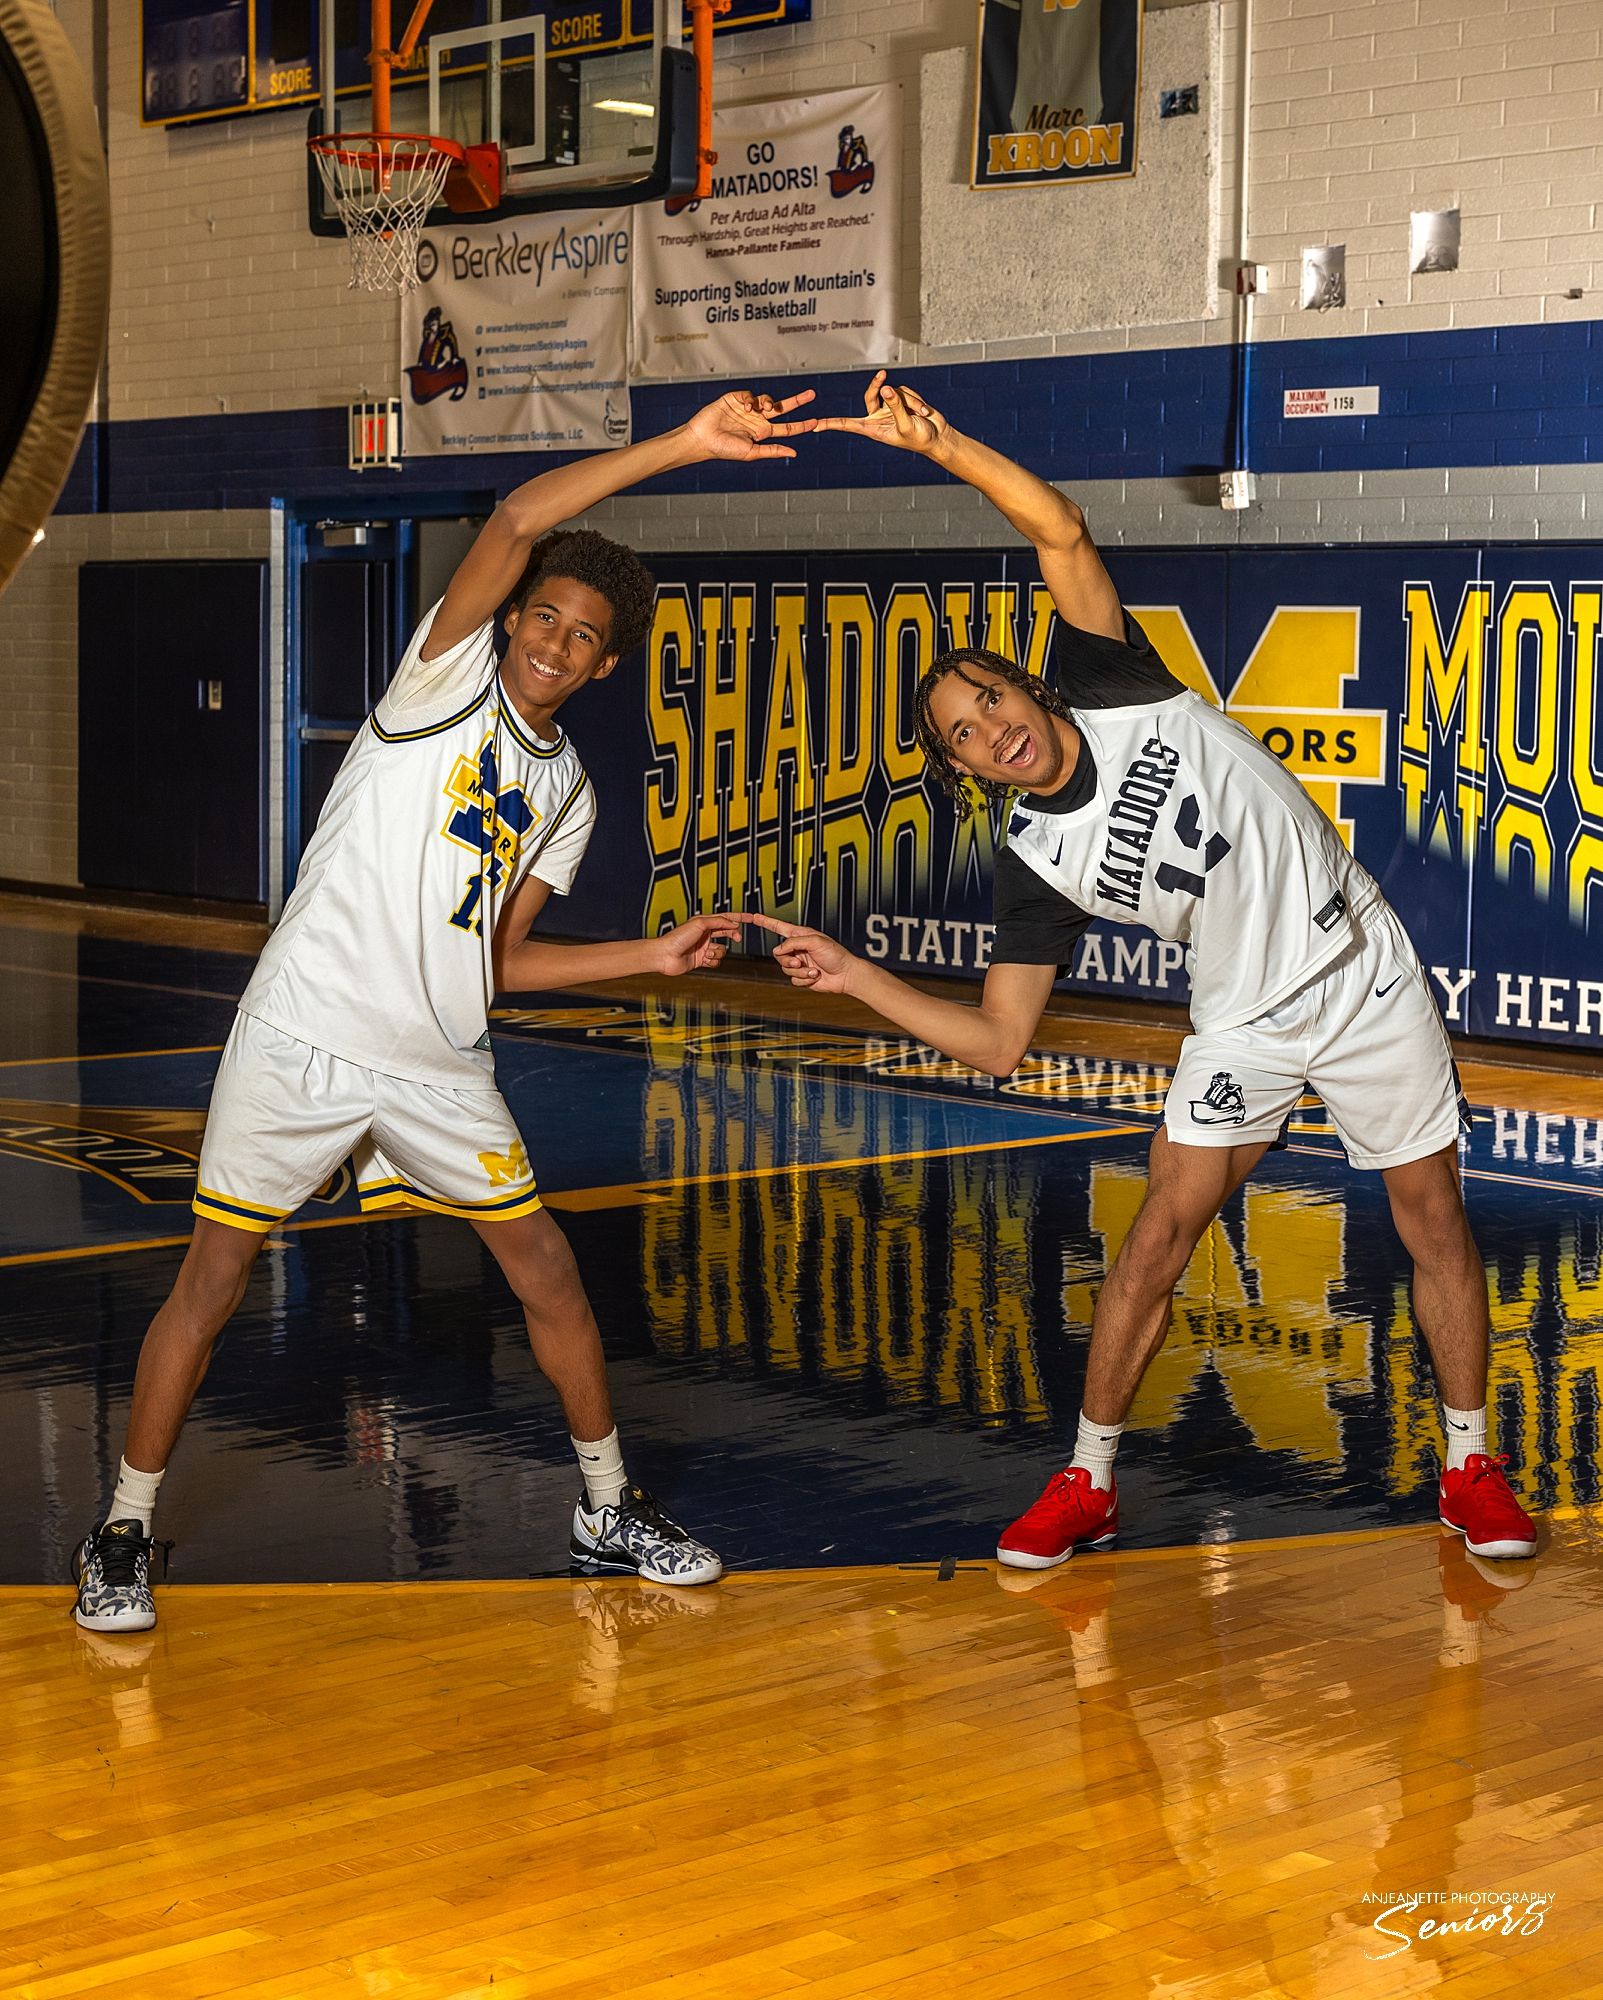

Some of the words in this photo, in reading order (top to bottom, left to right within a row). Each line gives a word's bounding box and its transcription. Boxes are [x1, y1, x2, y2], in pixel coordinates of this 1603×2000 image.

[551, 13, 602, 46] SCORE
[270, 67, 312, 96] SCORE
[1025, 104, 1087, 131] Marc
[747, 141, 775, 166] GO
[987, 122, 1123, 175] KROON
[711, 165, 818, 199] MATADORS!
[710, 212, 729, 226] Per
[732, 207, 768, 223] Ardua
[772, 205, 788, 218] Ad
[791, 202, 816, 216] Alta
[699, 228, 742, 243] Hardship,
[744, 224, 770, 238] Great
[772, 221, 808, 237] Heights
[809, 220, 825, 231] are
[706, 242, 778, 259] Hanna-Pallante
[780, 238, 821, 251] Families
[594, 286, 628, 297] Company
[655, 284, 731, 307] Supporting
[735, 278, 790, 299] Shadow
[794, 269, 875, 293] Mountain's
[706, 305, 740, 324] Girls
[744, 298, 817, 321] Basketball
[1289, 390, 1326, 401] MAXIMUM
[1334, 396, 1354, 409] 1158
[1285, 403, 1329, 415] OCCUPANCY
[568, 428, 584, 439] LLC
[1097, 737, 1180, 912] MATADORS
